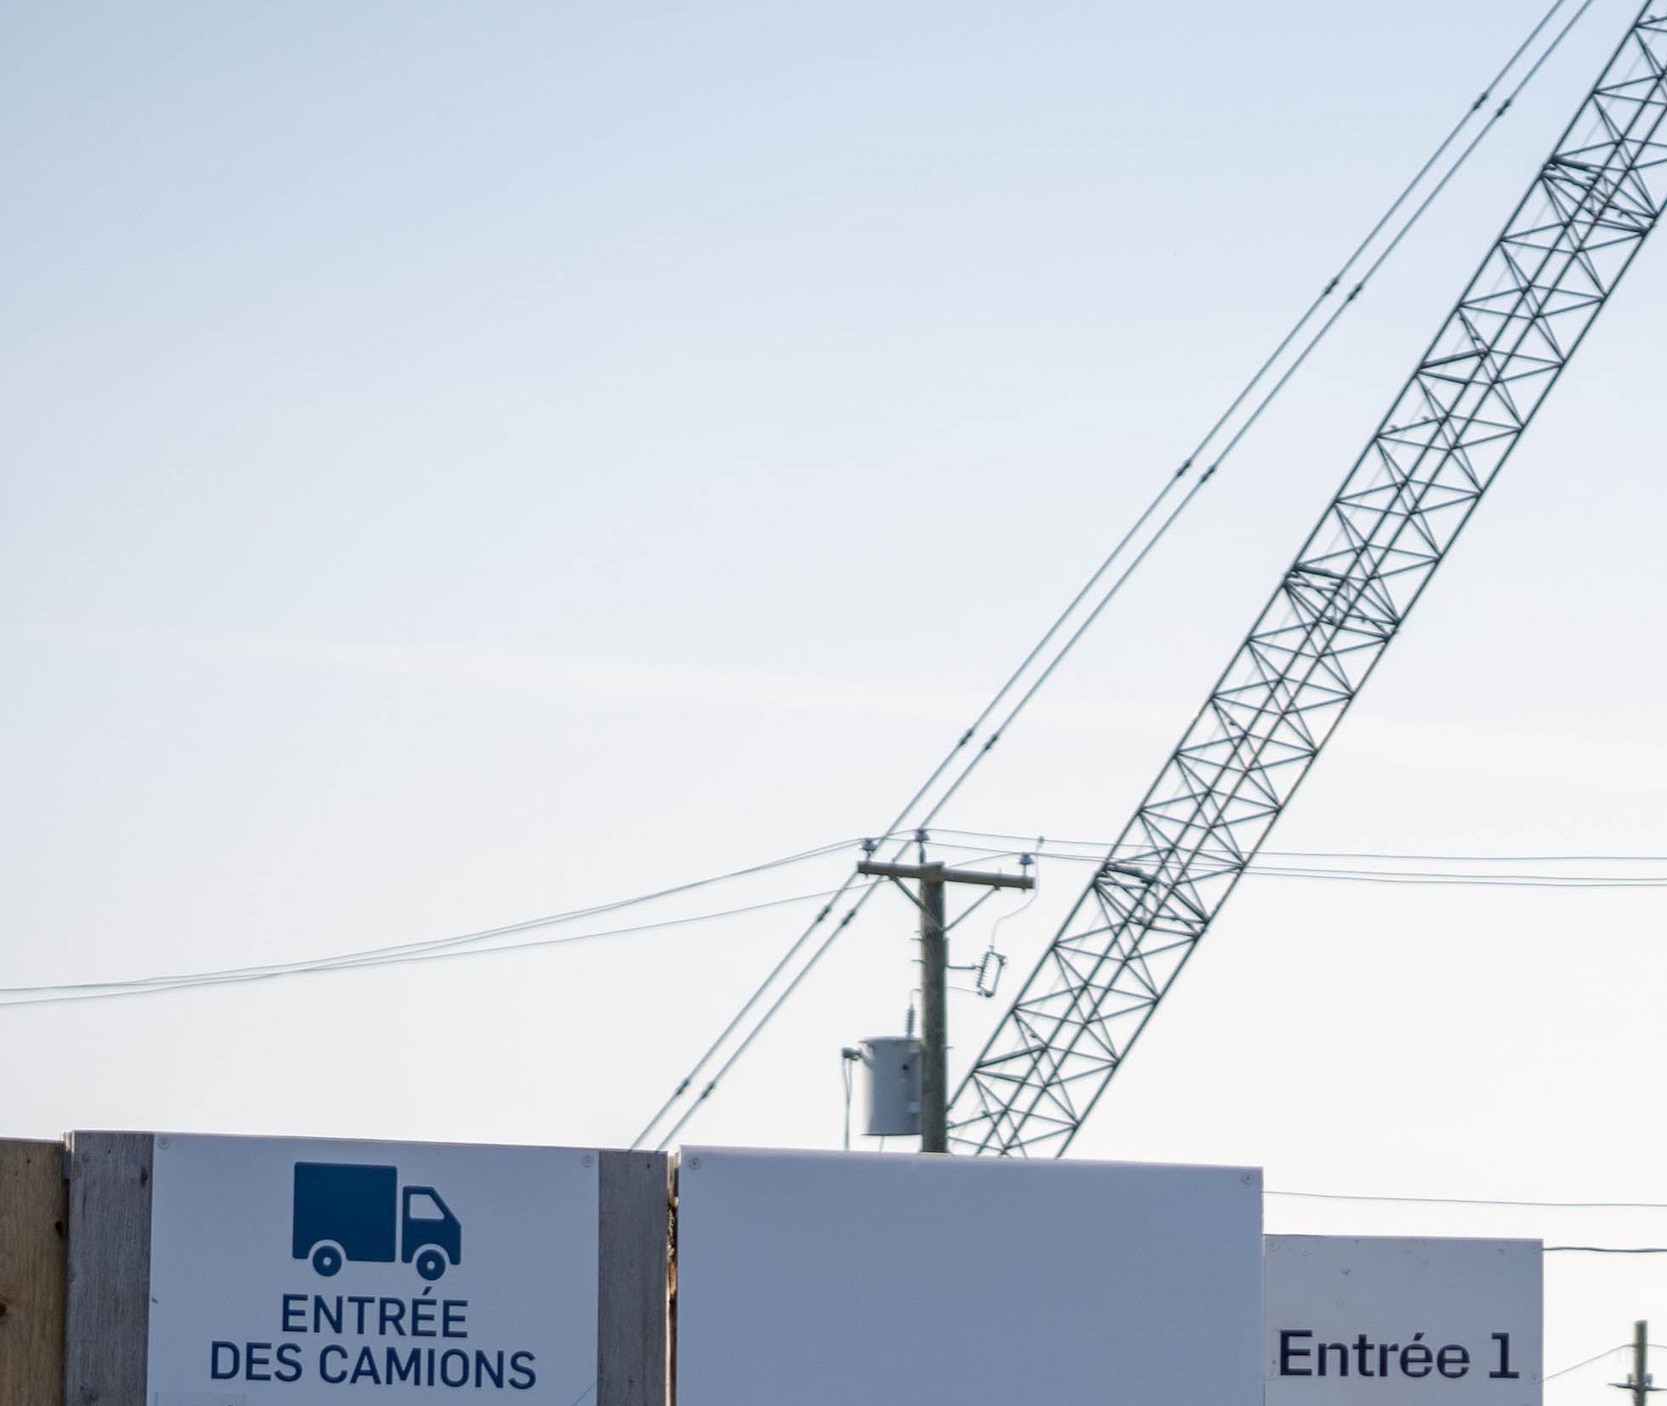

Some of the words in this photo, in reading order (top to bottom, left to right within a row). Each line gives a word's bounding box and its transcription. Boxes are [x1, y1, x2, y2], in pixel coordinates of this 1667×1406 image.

[281, 1287, 469, 1338] ENTRÉE
[210, 1341, 303, 1383] DES
[318, 1344, 537, 1390] CAMIONS
[1278, 1330, 1471, 1379] Entrée
[1488, 1332, 1520, 1379] 1
